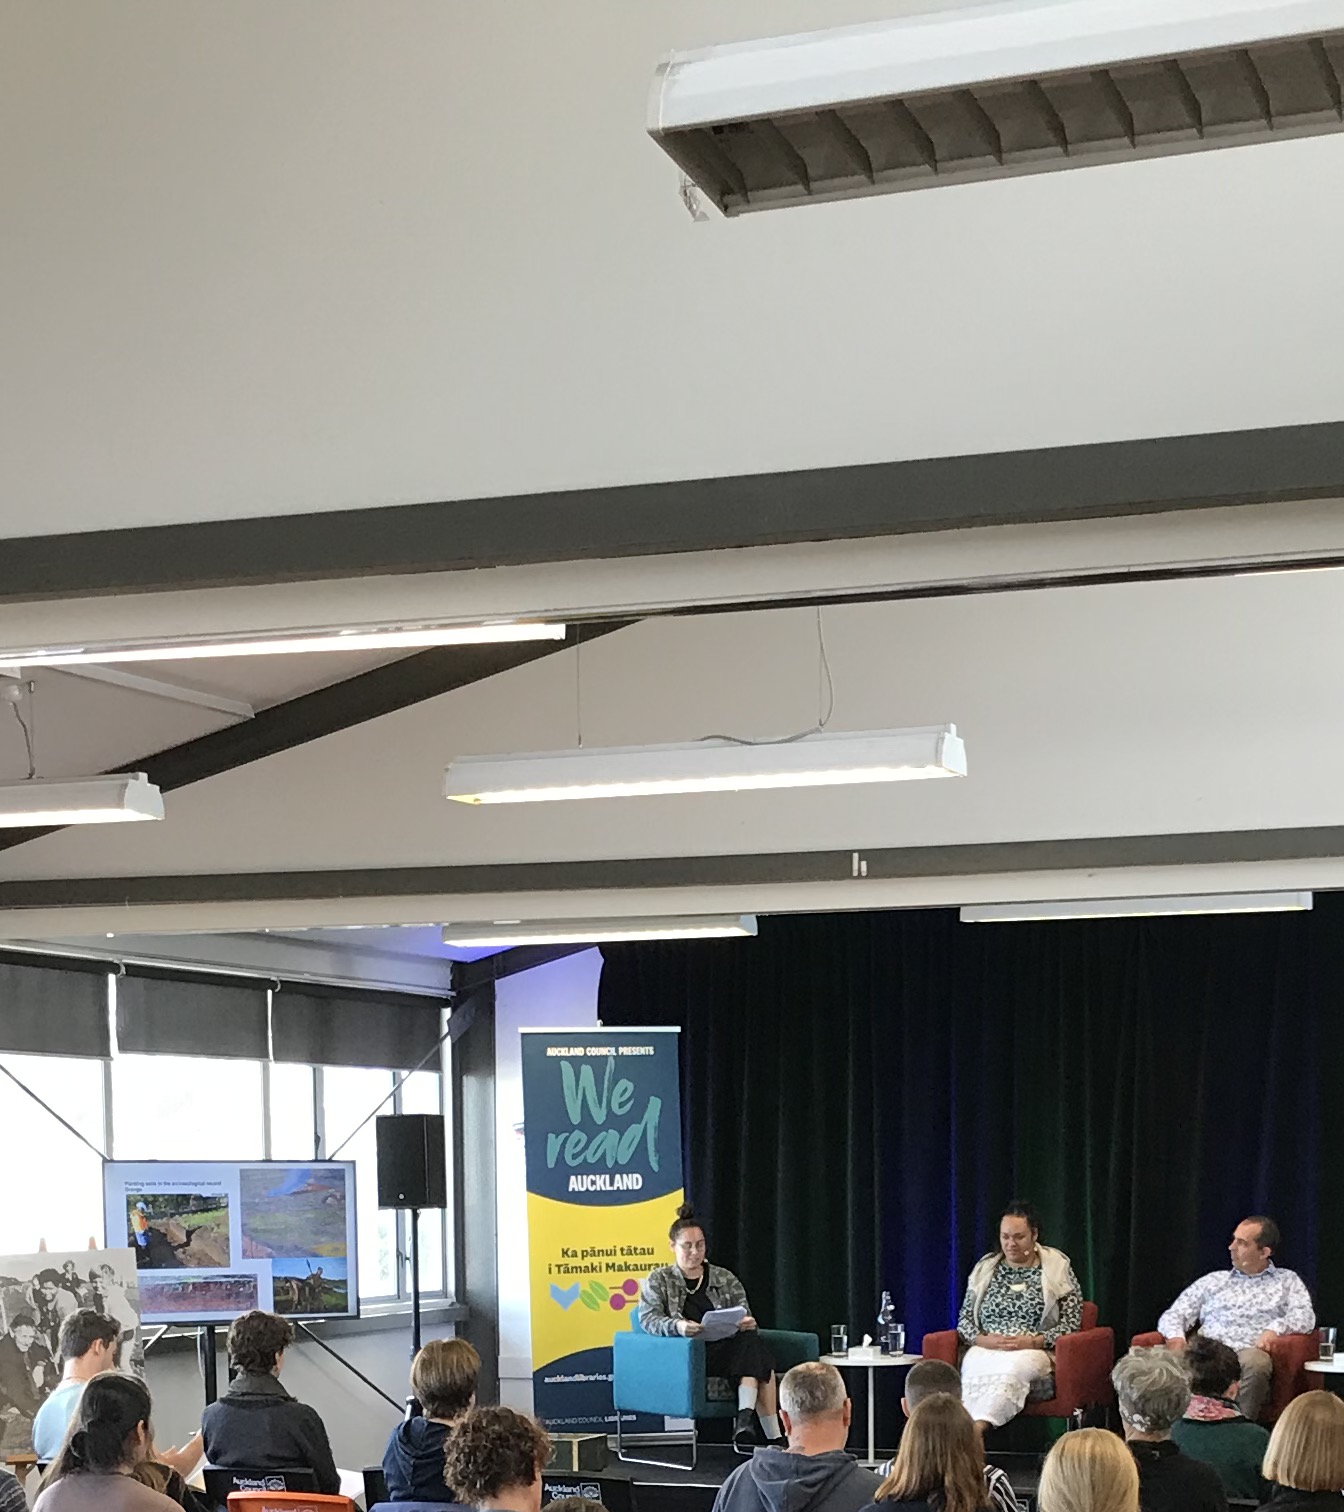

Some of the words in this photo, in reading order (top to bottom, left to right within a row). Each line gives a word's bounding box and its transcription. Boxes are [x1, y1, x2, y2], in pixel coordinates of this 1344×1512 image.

[546, 1047, 585, 1056] AUCKLAND
[586, 1046, 617, 1056] COUNCIL
[618, 1046, 654, 1055] PRESENTS
[560, 1056, 634, 1125] We
[547, 1095, 662, 1173] read
[568, 1173, 643, 1192] AUCKLAND
[561, 1247, 578, 1258] Ka
[581, 1246, 617, 1260] pānui
[620, 1245, 654, 1256] tātau
[548, 1263, 552, 1274] i
[555, 1262, 602, 1274] Tāmaki
[233, 1477, 265, 1487] Auckland
[545, 1484, 580, 1493] Auckland
